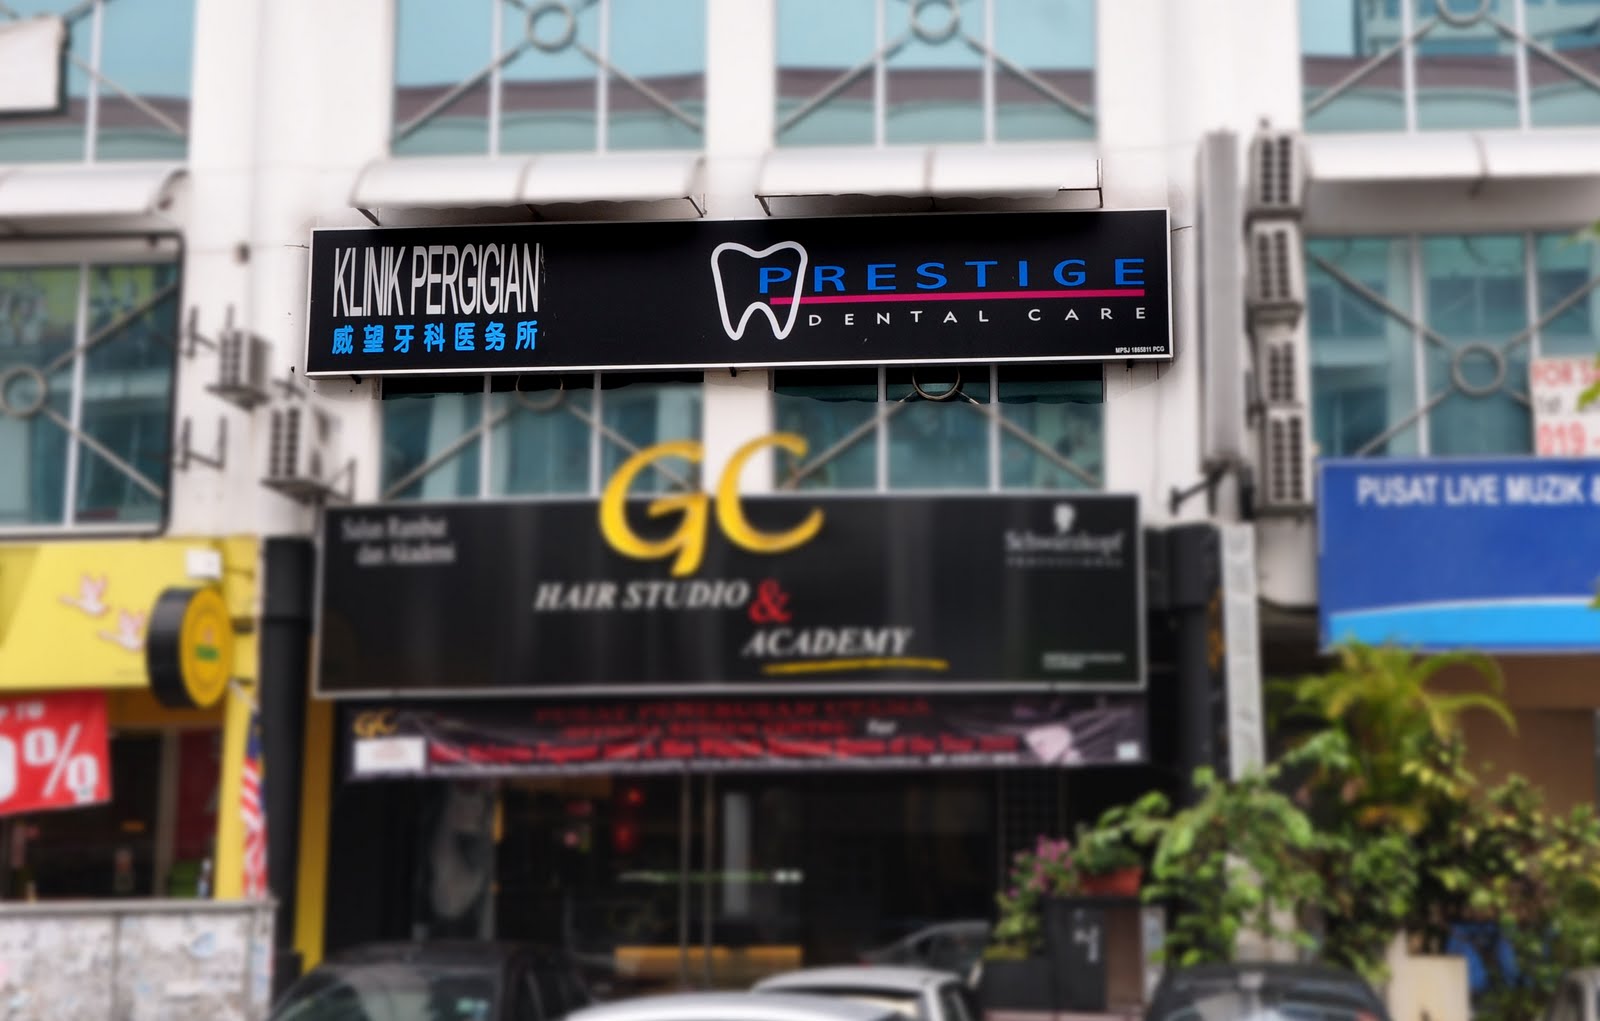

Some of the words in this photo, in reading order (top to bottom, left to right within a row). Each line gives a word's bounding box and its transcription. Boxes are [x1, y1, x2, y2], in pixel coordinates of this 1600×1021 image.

[332, 245, 405, 318] KLINIK
[410, 242, 540, 316] PERGIGIAN
[758, 258, 1146, 295] PRESTIGE
[808, 309, 989, 327] DENTAL
[1028, 307, 1146, 322] CARE
[331, 320, 539, 355] 威望牙科医务所
[598, 432, 824, 577] GC
[1357, 474, 1438, 505] PUSAT
[1445, 474, 1498, 505] LIVE
[1505, 473, 1585, 504] MUZIK
[534, 582, 616, 612] HAIR
[622, 579, 750, 610] STUDIO
[747, 579, 793, 624] &
[741, 626, 914, 658] ACADEMY
